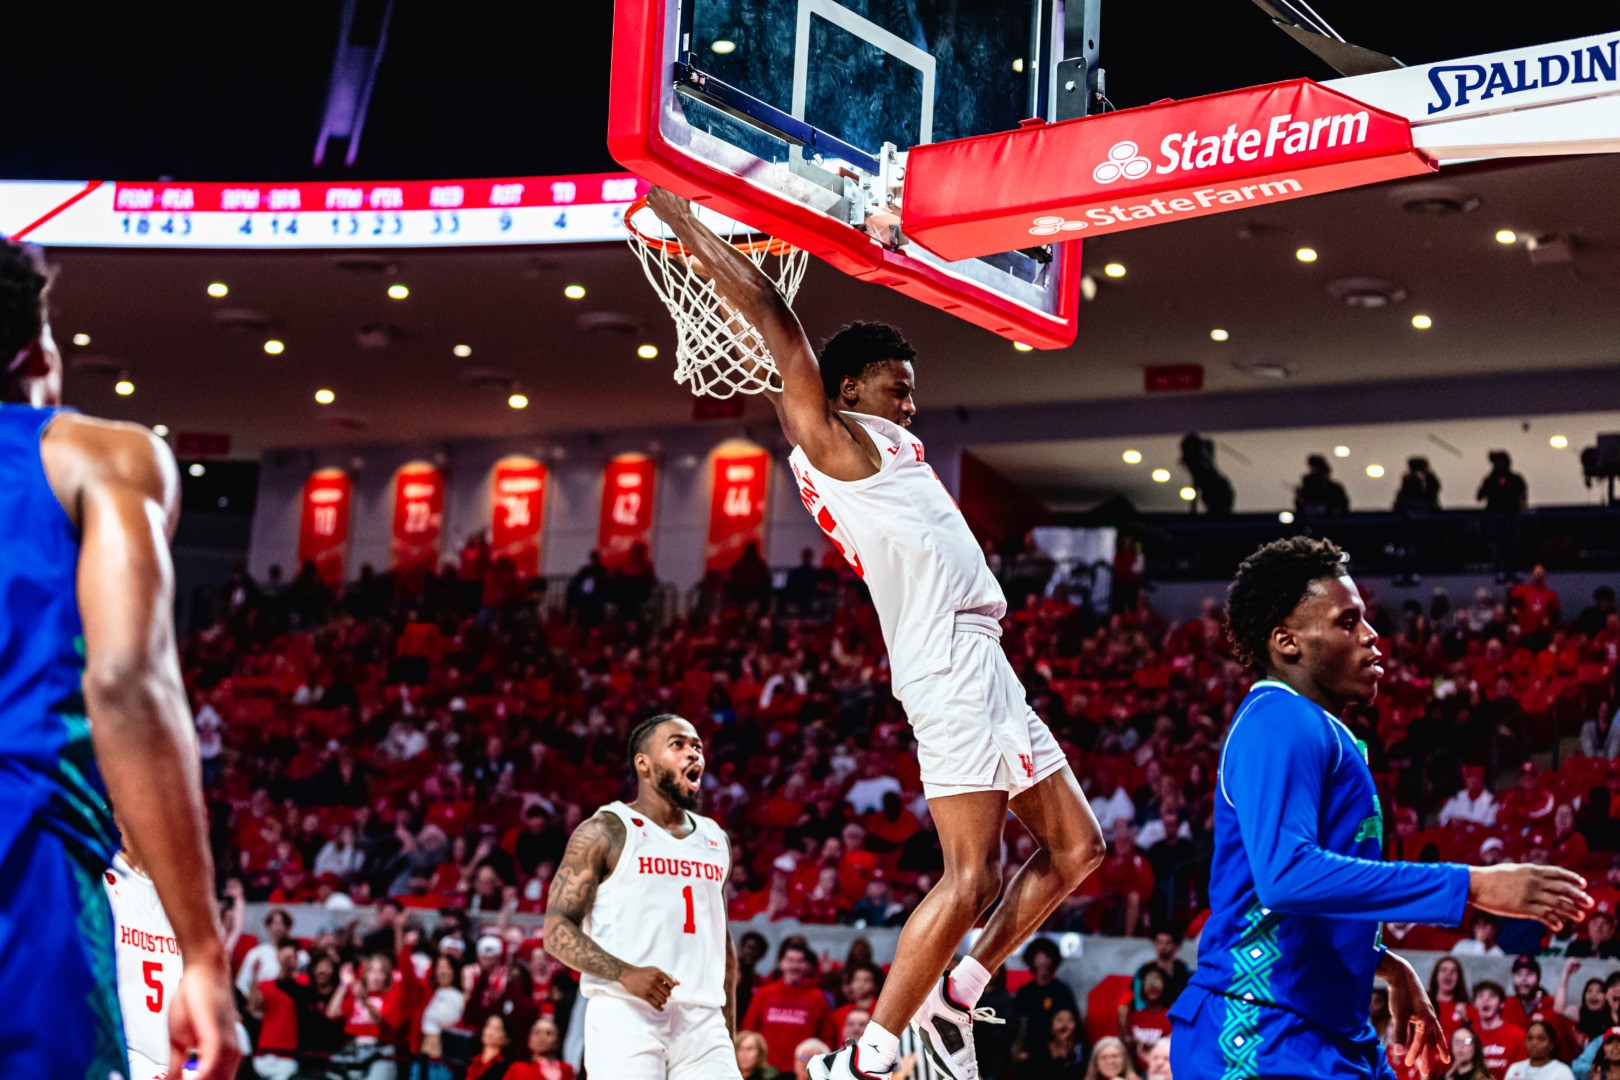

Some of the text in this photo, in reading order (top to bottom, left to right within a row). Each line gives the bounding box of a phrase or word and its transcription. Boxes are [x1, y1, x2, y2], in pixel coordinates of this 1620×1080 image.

[1428, 40, 1620, 115] SPALDIN
[638, 856, 723, 883] HOUSTON
[682, 885, 696, 934] 1
[142, 960, 164, 1013] 5
